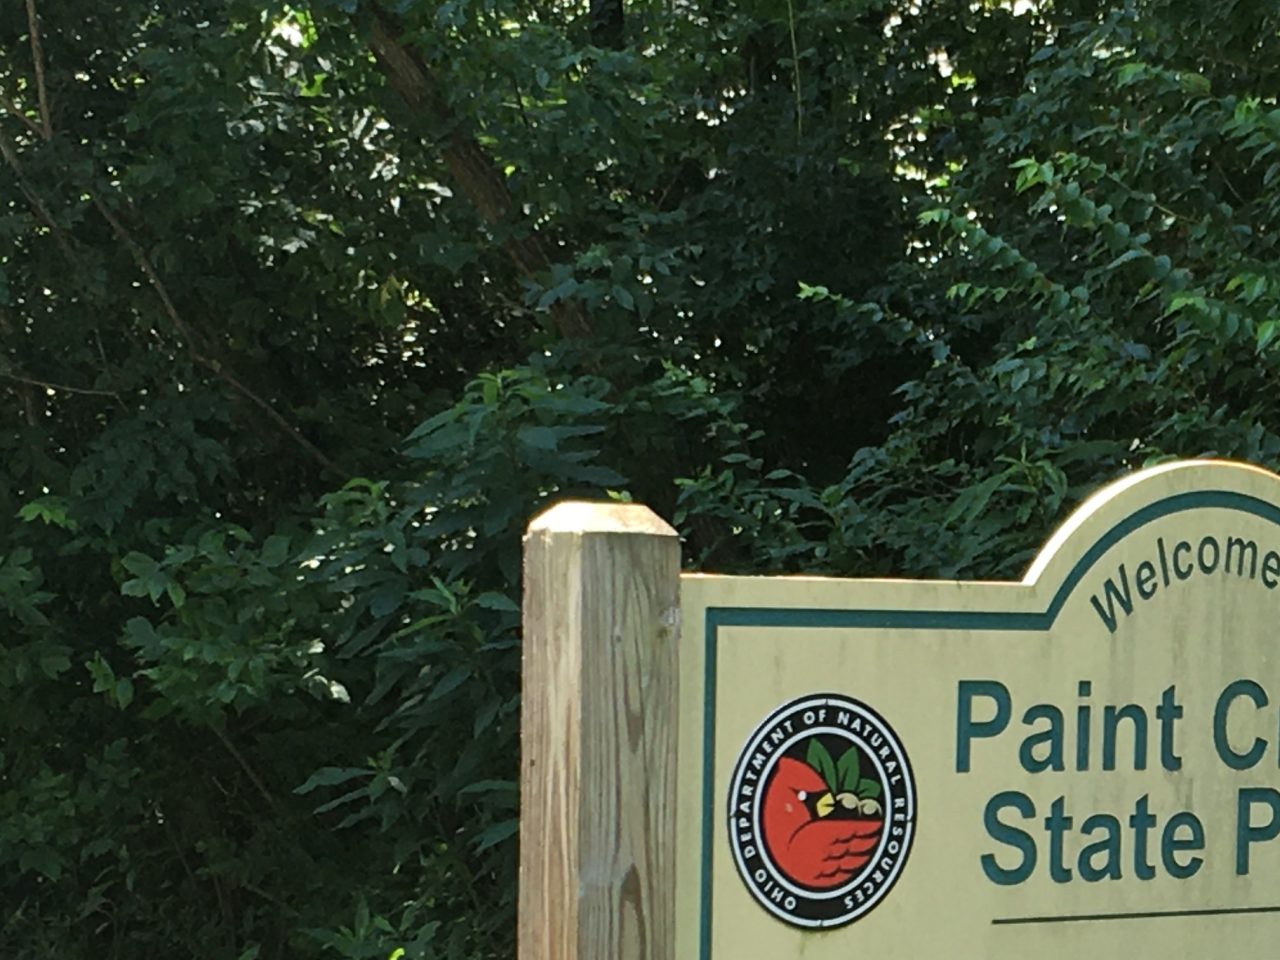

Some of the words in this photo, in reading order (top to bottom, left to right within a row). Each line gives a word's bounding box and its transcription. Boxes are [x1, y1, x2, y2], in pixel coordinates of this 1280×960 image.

[803, 708, 828, 725] OF
[836, 710, 903, 786] NATURAL
[955, 679, 1184, 774] Paint
[738, 720, 795, 860] DEPARTMENT
[842, 797, 906, 910] RESOURCES
[980, 790, 1206, 886] State
[754, 868, 797, 911] OHIO
